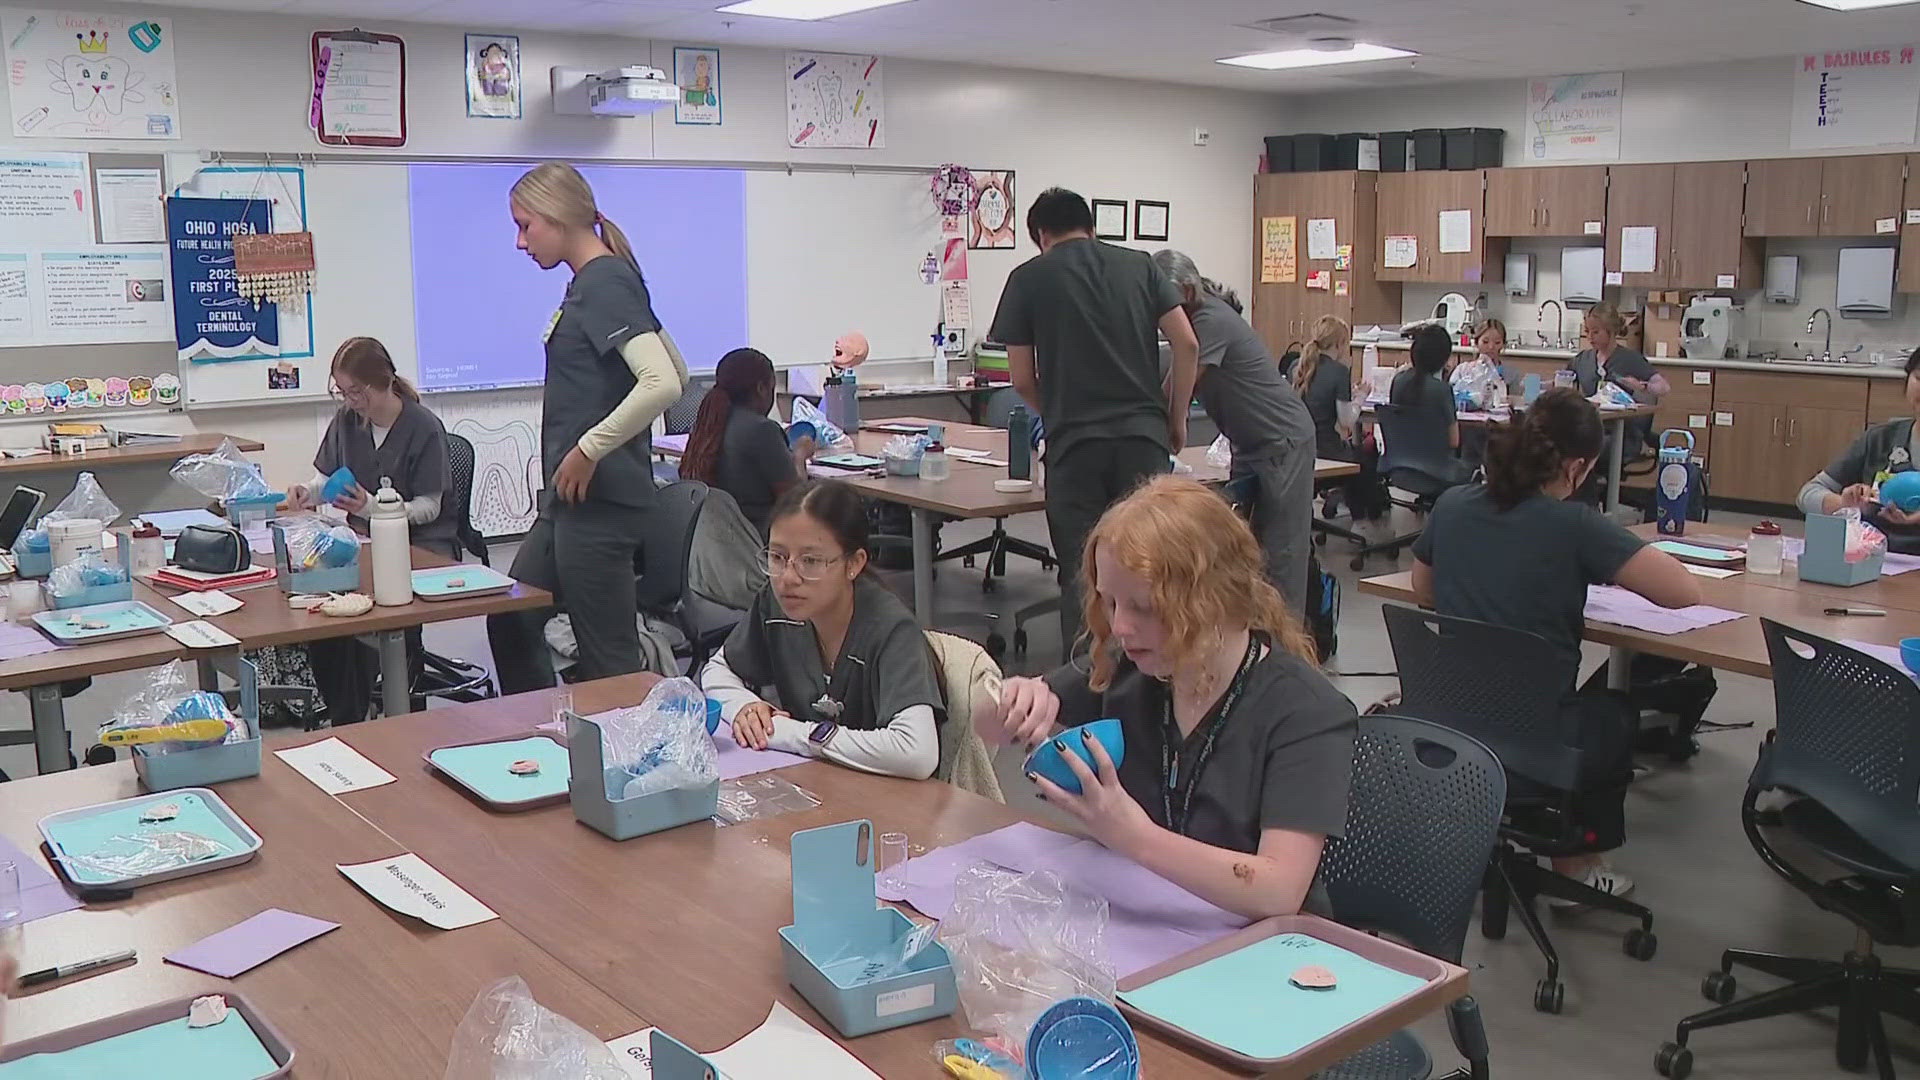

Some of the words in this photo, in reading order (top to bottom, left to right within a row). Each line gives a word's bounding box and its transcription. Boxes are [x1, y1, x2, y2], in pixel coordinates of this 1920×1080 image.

[185, 221, 216, 235] OHIO
[222, 222, 257, 235] HOSA
[176, 239, 199, 250] FUTURE
[200, 240, 221, 250] HEALTH
[209, 269, 239, 280] 2025
[190, 281, 219, 292] FIRST
[209, 311, 243, 321] DENTAL
[196, 322, 257, 333] TERMINOLOGY
[421, 892, 447, 910] Alexis
